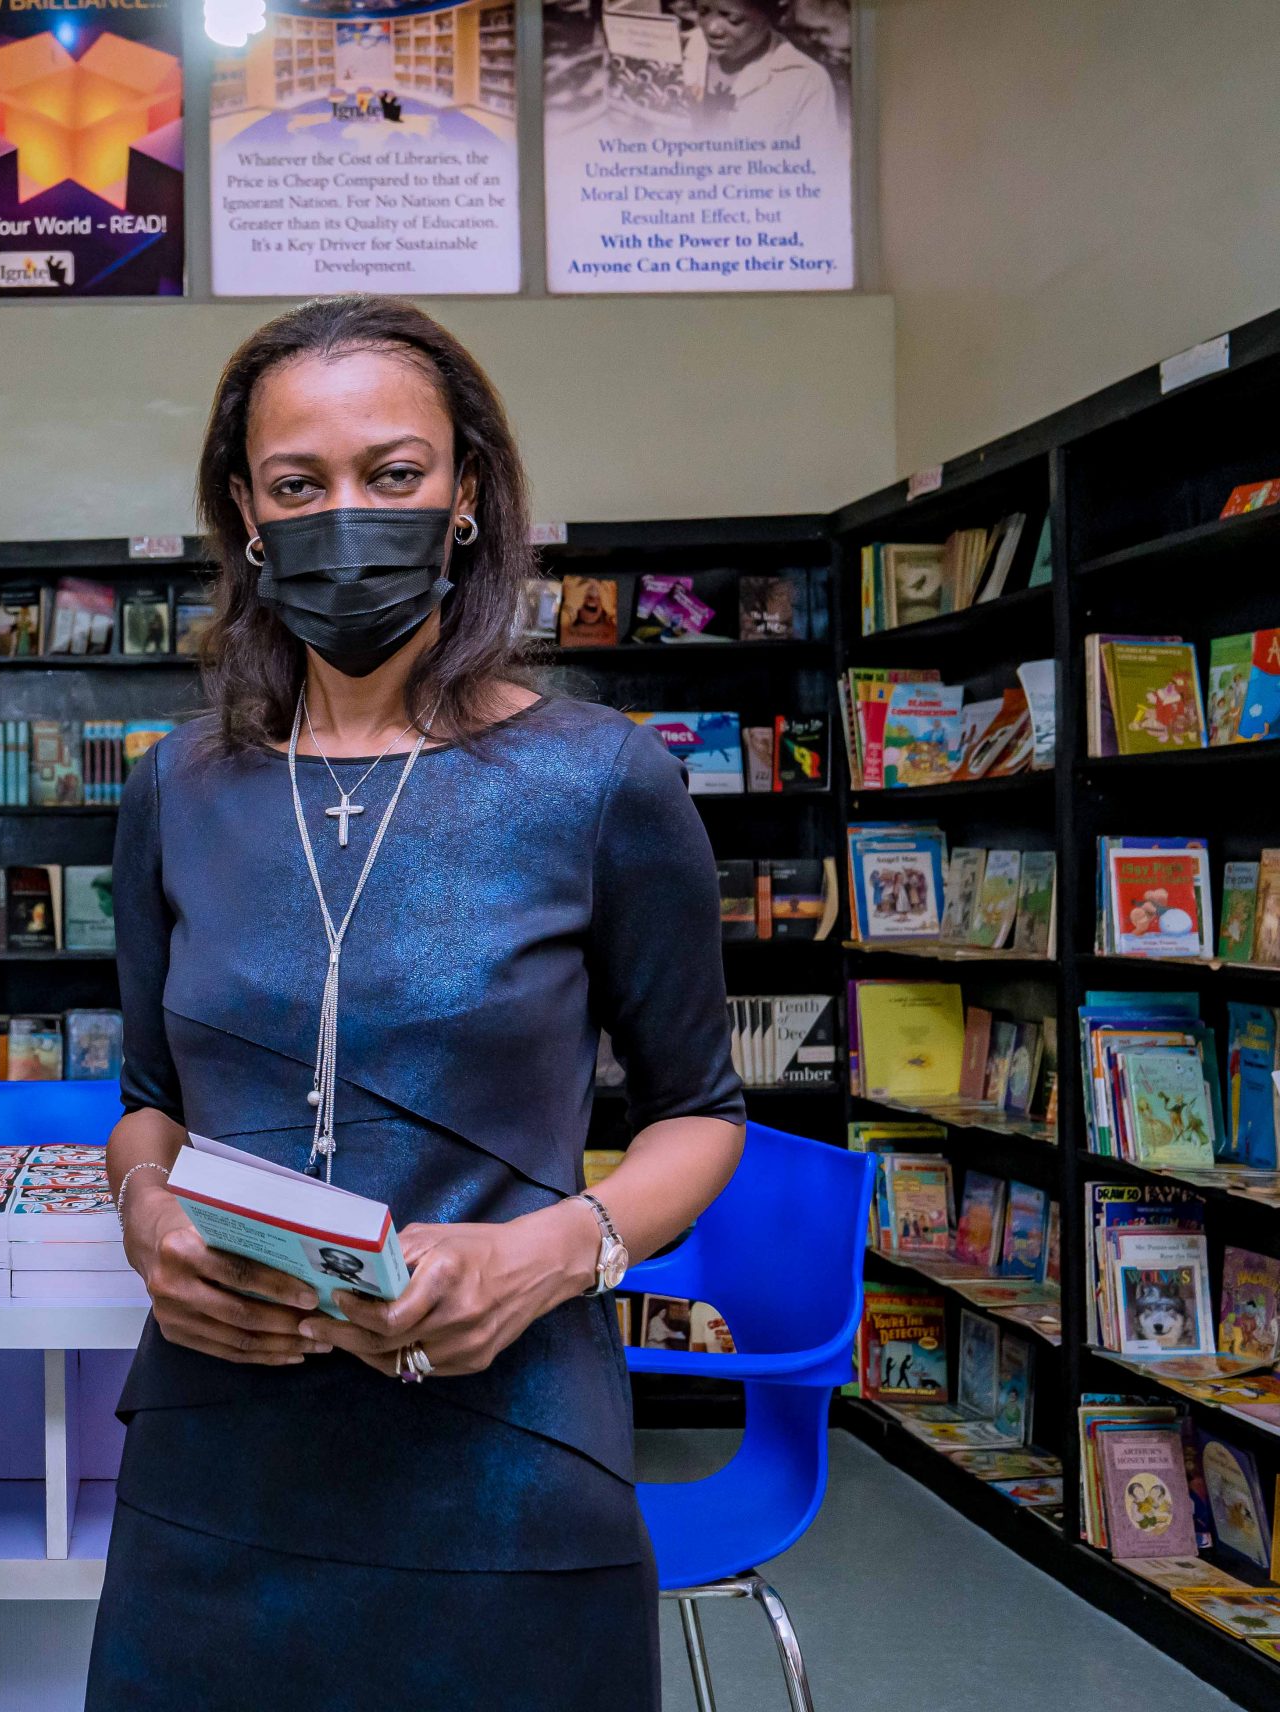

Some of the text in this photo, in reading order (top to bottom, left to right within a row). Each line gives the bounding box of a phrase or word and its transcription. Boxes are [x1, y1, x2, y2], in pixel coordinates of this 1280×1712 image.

[598, 135, 800, 157] When Opportunities and
[238, 151, 488, 167] Whatever the Cost Libraries, the
[585, 161, 713, 180] Understandings
[718, 163, 741, 175] are
[227, 173, 460, 190] Price Cheap Compared that
[581, 183, 821, 204] Moral Decay and Crime the
[223, 194, 484, 214] Ignorant Nation. For Nation Can
[34, 216, 91, 234] World
[110, 216, 167, 234] READ!
[229, 215, 498, 232] Greater than Quality Education.
[621, 209, 695, 225] Resultant
[755, 208, 782, 223] but
[252, 236, 478, 253] It's Key Driver for Sustainable
[601, 233, 642, 249] With
[648, 233, 673, 249] the
[679, 233, 729, 248] Power
[315, 259, 415, 276] Development.
[569, 255, 837, 278] Anyone Can Change their Story.
[662, 730, 695, 743] flect
[777, 1000, 819, 1014] Tenth
